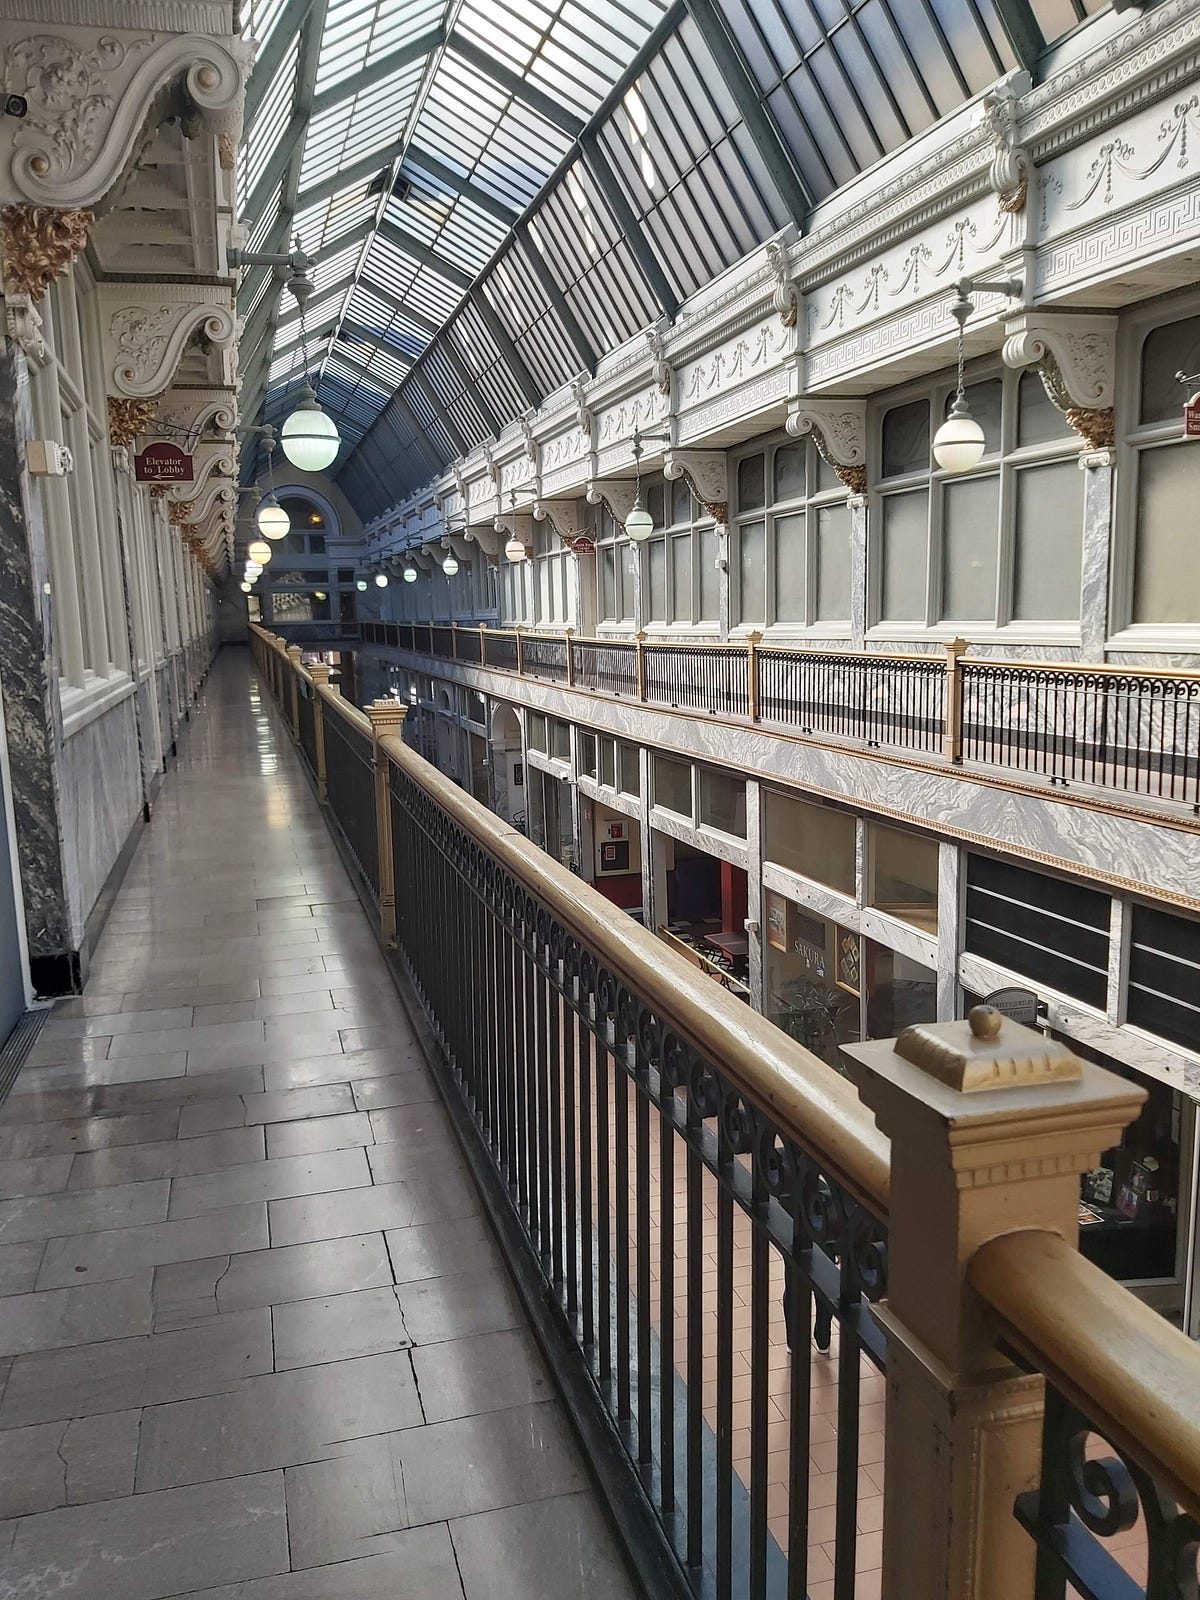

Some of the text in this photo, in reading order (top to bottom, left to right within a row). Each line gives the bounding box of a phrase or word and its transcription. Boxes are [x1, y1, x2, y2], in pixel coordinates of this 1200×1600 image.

[146, 457, 182, 465] Elevator
[144, 466, 184, 475] to Lobby
[794, 940, 825, 968] SAKURA
